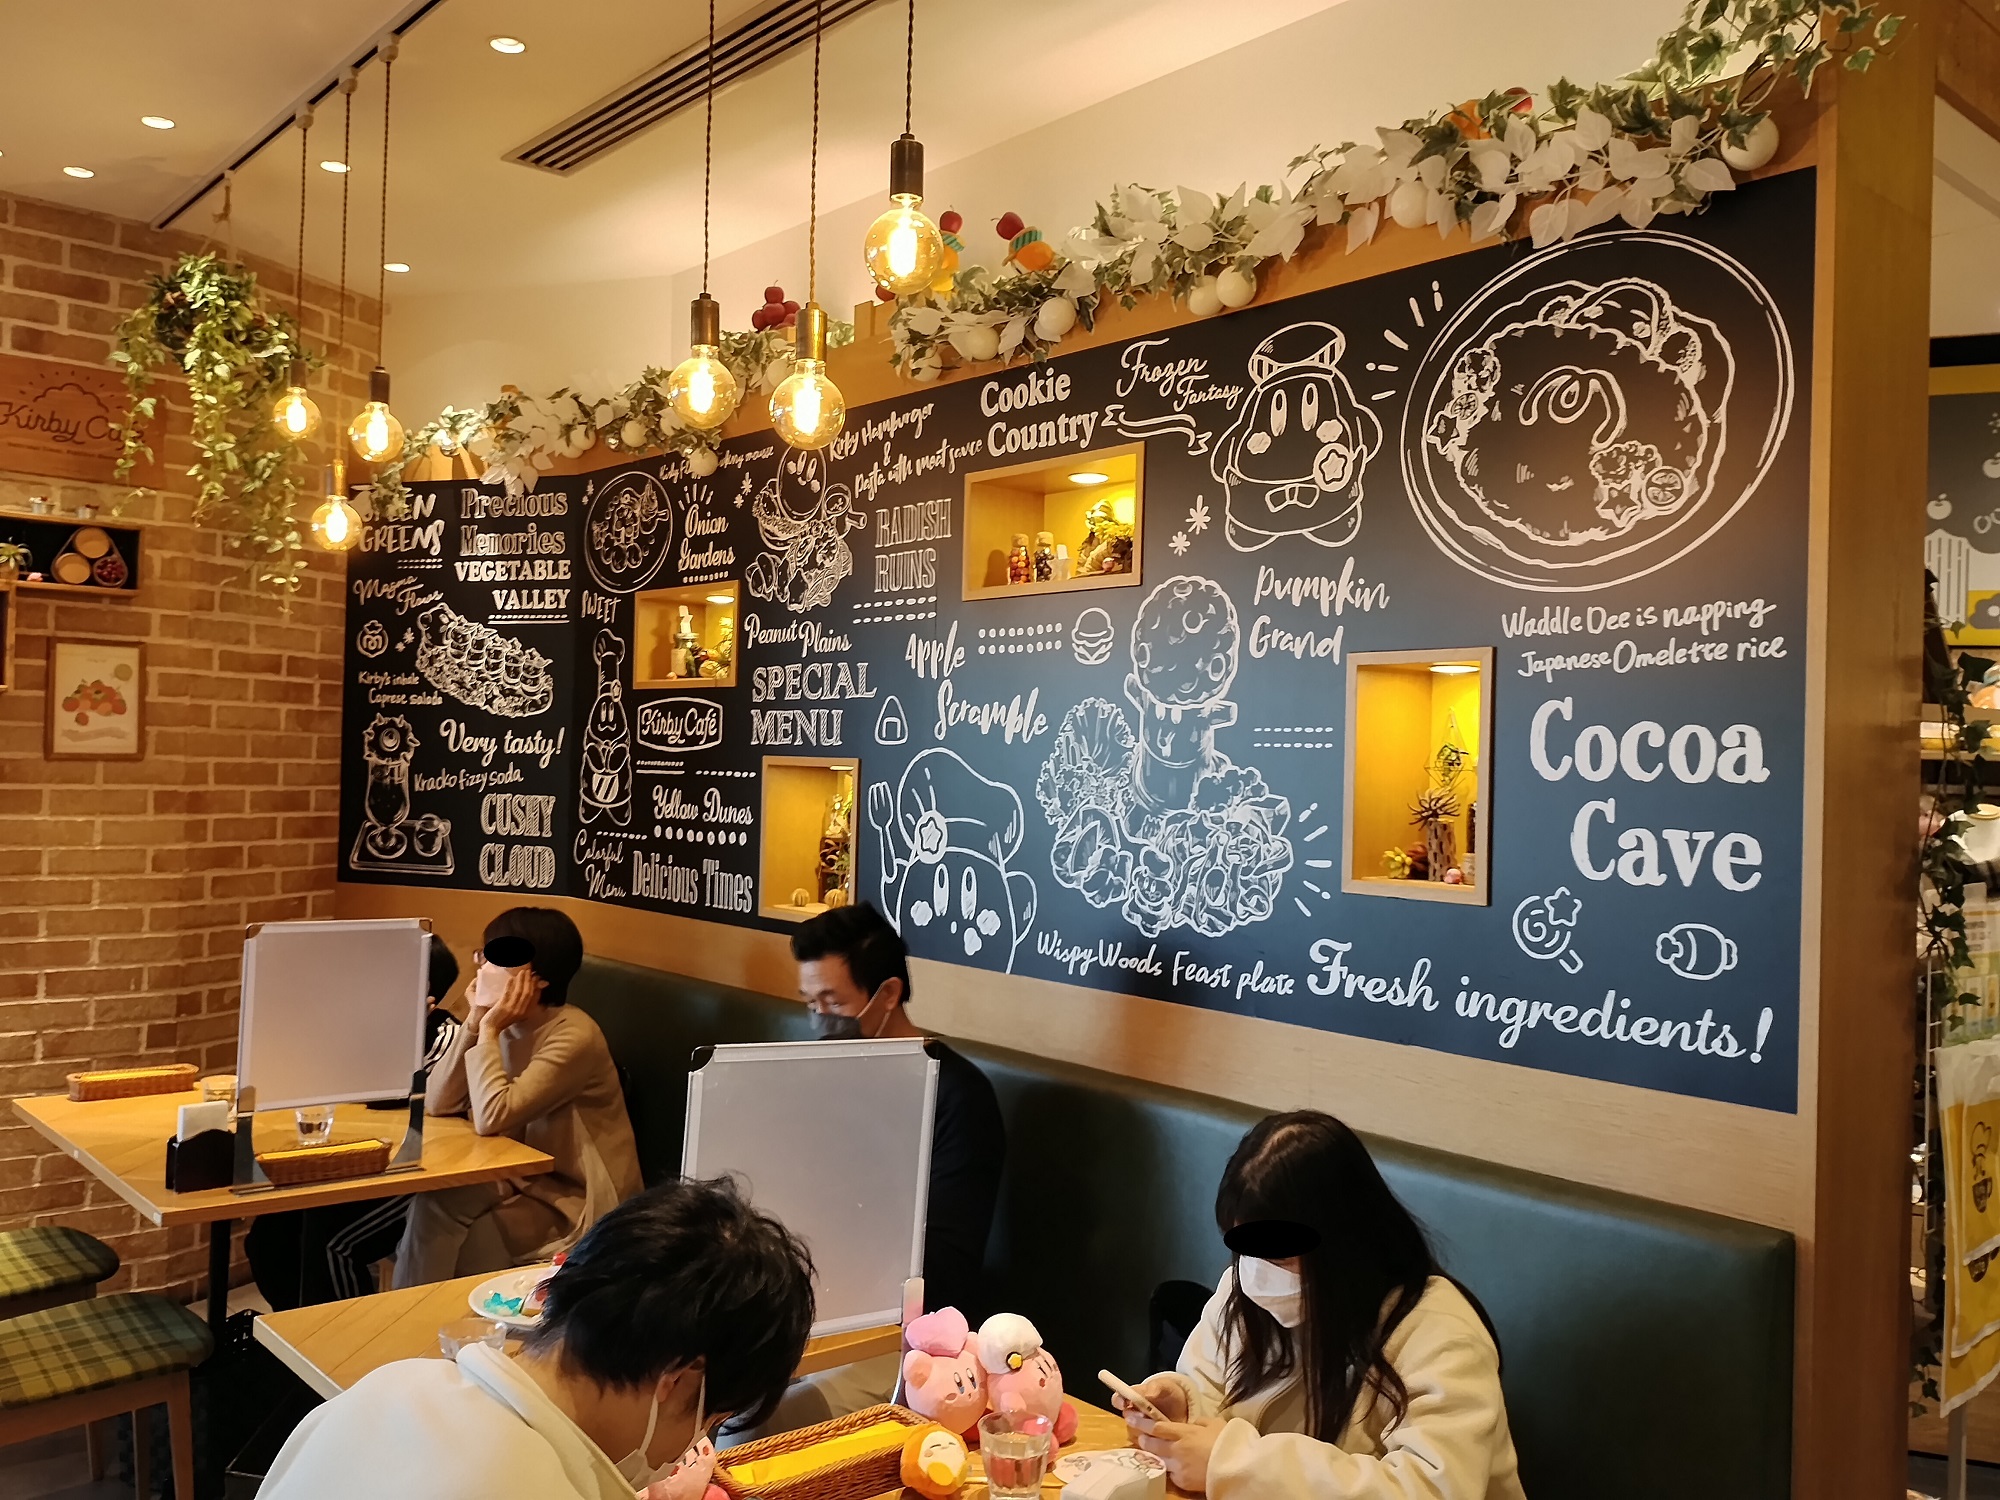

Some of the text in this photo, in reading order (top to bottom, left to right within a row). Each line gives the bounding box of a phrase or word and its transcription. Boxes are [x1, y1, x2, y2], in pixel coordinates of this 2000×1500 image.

[980, 368, 1070, 418] Cookie
[1116, 338, 1244, 412] Frozen Fantasy
[0, 402, 85, 444] Kirby
[862, 403, 934, 446] Hamburger
[988, 411, 1098, 456] Country
[888, 454, 913, 484] with
[916, 438, 950, 476] meat
[949, 439, 984, 474] sauce
[460, 488, 568, 518] Precious
[684, 504, 729, 538] Onion
[874, 498, 952, 548] RADISH
[360, 520, 444, 556] GREENS
[460, 522, 566, 556] Memories
[678, 538, 736, 572] Gardens
[352, 576, 418, 605] Magma
[454, 560, 571, 582] VEGETABLE
[874, 548, 936, 593] RUINS
[492, 589, 571, 610] VALLEY
[581, 590, 621, 624] SWEET
[1502, 598, 1777, 638] Waddle Dee is napping
[744, 613, 852, 658] Peanut Plains
[905, 620, 966, 680] Apple
[1249, 614, 1344, 665] Grand
[1517, 636, 1788, 682] Japanese Omelette rice
[752, 662, 878, 702] SPECIAL
[642, 706, 718, 744] Kirby Café
[750, 708, 844, 746] MENU
[934, 679, 1048, 745] Scramble
[440, 718, 565, 769] Very tasty!
[1530, 696, 1770, 784] Cocoa
[414, 768, 456, 792] Kracko
[489, 762, 524, 786] soda
[480, 792, 556, 837] CUSHY
[652, 784, 754, 825] Yellow Dunes
[478, 842, 556, 888] CLOUD
[574, 828, 624, 872] Colorful
[1570, 798, 1762, 892] Cave
[584, 864, 626, 898] Menu
[632, 850, 753, 913] Delicious Times
[1037, 930, 1296, 1000] Wispy Woods Feast plate
[1306, 938, 1774, 1064] Fresh ingredients!
